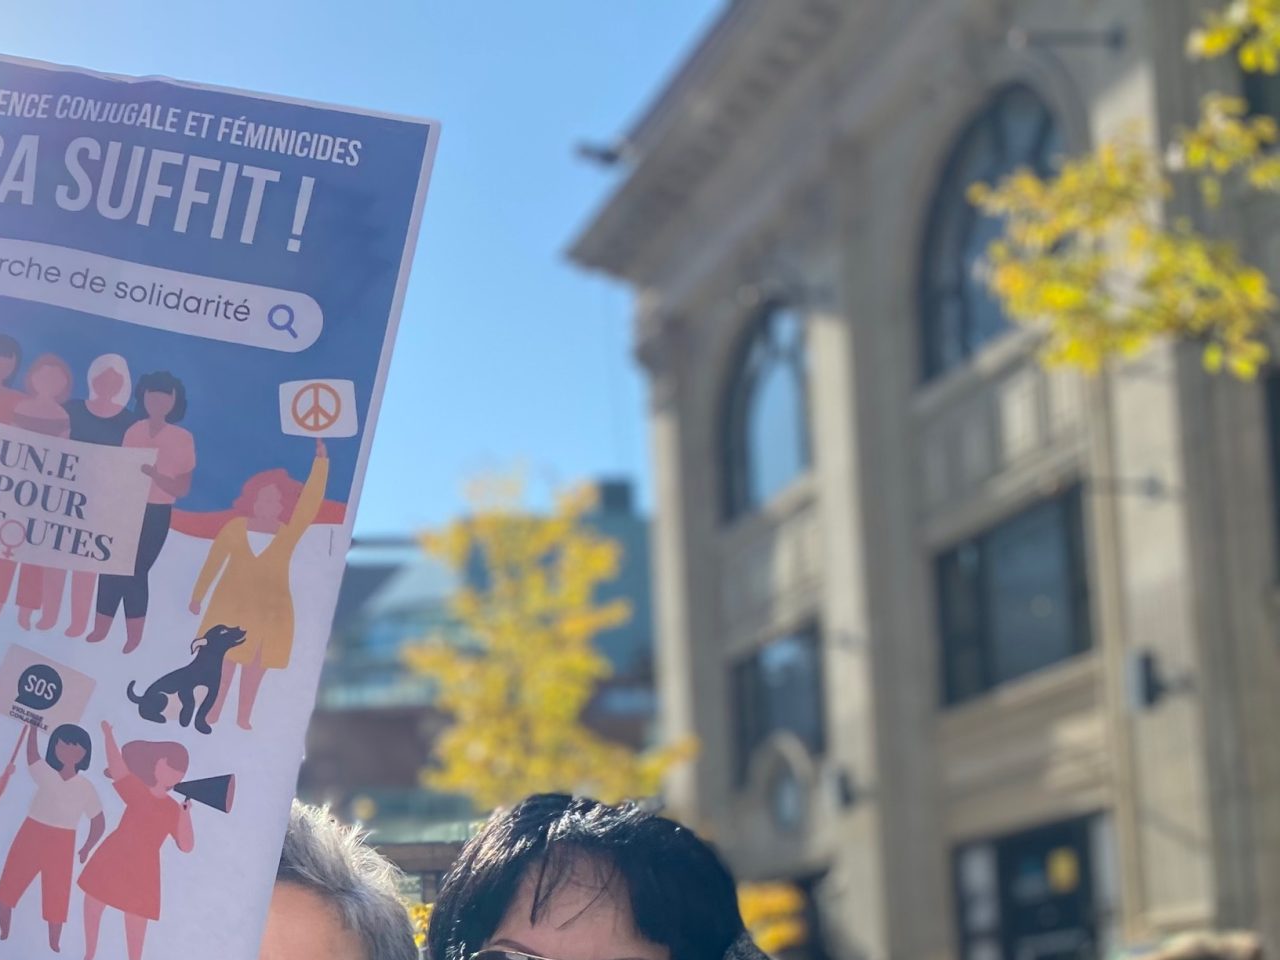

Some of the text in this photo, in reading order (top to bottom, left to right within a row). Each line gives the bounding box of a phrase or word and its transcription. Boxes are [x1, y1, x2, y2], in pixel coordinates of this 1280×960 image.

[55, 94, 181, 133] CONJUGALE
[184, 111, 215, 138] ET
[217, 116, 362, 166] FÉMINICIDES
[55, 136, 281, 244] SUFFIT
[70, 268, 106, 294] de
[114, 280, 251, 322] solidarité
[0, 438, 79, 481] UN.E
[24, 674, 56, 700] SOS
